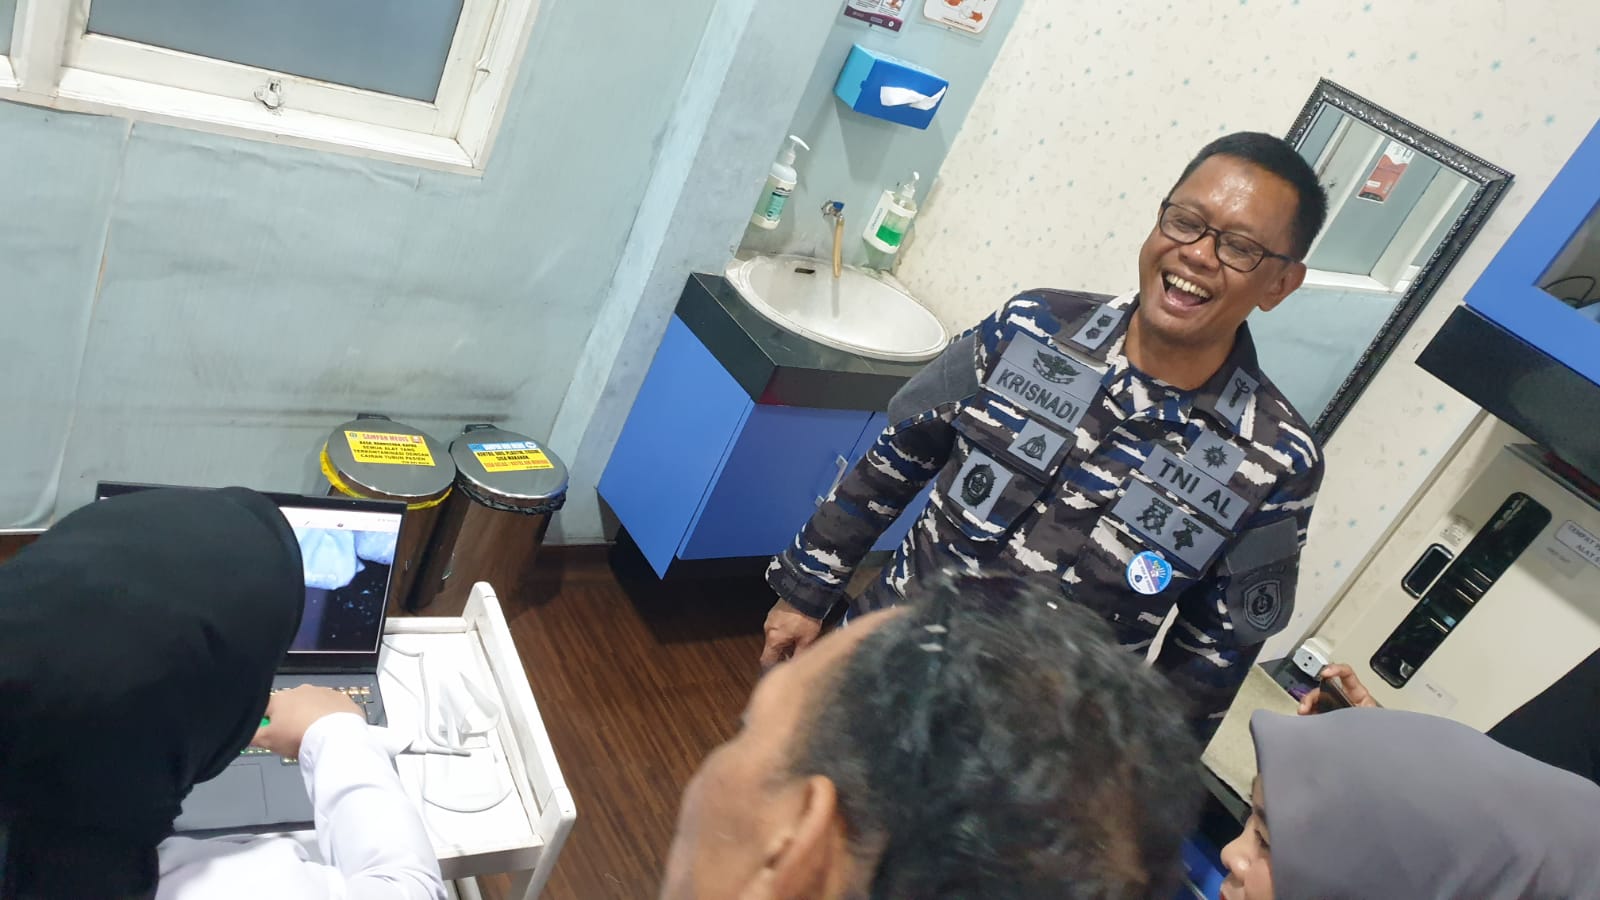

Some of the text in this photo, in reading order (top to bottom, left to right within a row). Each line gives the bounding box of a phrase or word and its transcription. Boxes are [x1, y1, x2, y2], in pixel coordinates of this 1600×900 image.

[996, 368, 1079, 423] KRISNADI
[1159, 457, 1231, 519] TNI AL
[1576, 544, 1595, 559] ALAT
